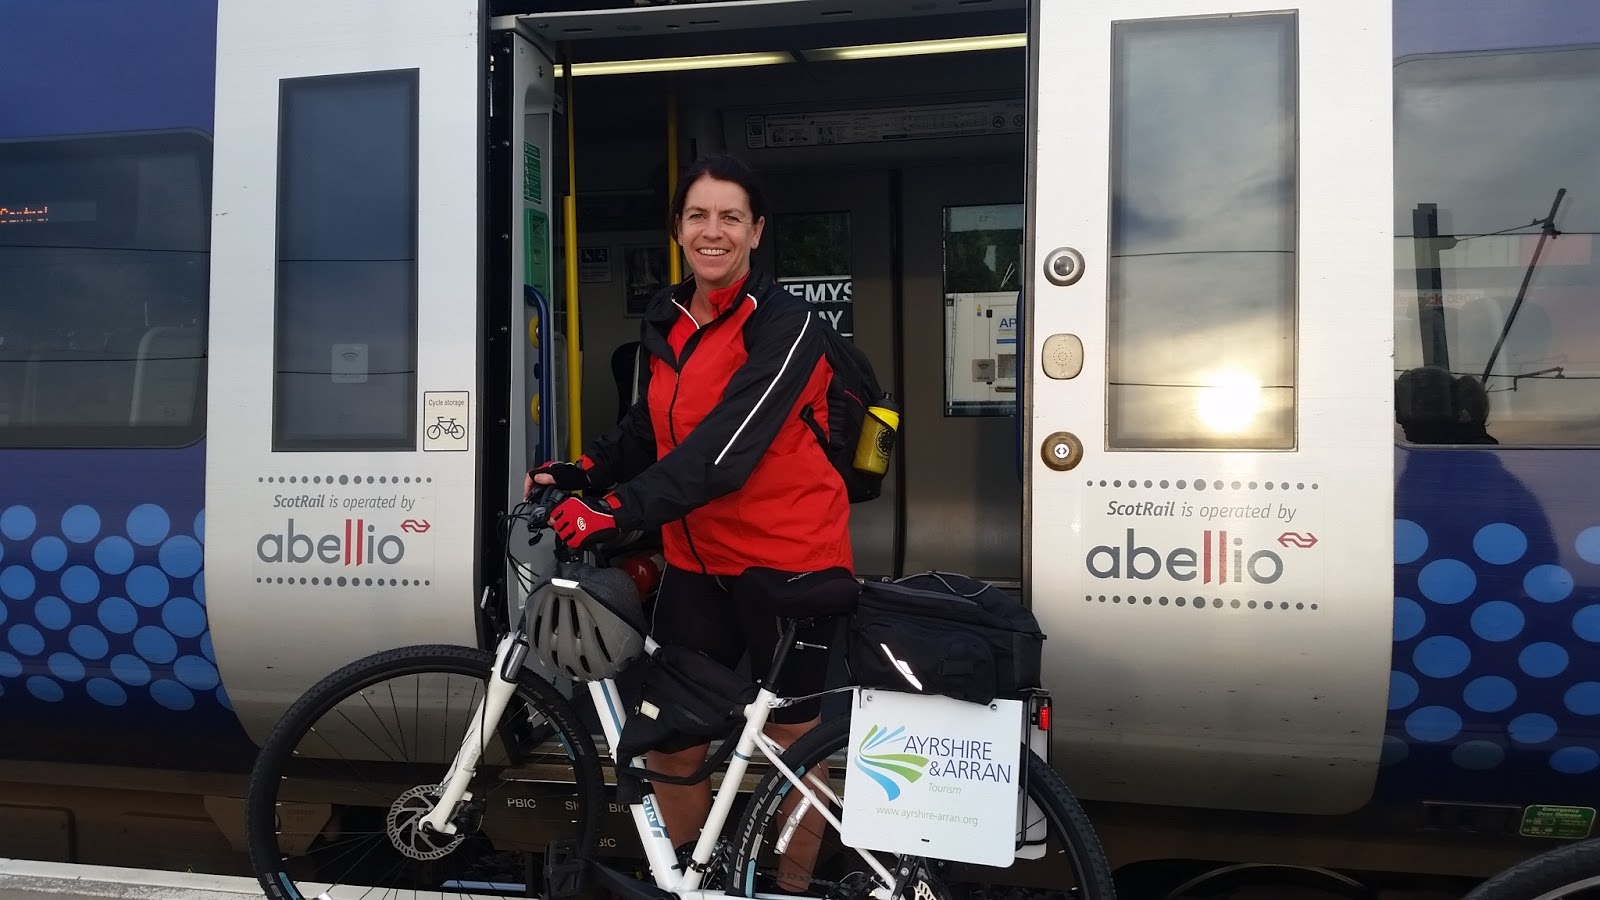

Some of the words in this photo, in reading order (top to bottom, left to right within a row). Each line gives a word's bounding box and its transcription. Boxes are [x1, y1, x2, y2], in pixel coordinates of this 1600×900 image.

[783, 282, 852, 302] EMYS
[428, 399, 443, 407] Cycle
[444, 399, 465, 407] storage
[273, 494, 325, 508] ScotRail
[329, 495, 338, 508] is
[343, 495, 397, 511] operated
[400, 495, 415, 511] by
[1106, 500, 1176, 517] ScotRail
[1181, 501, 1194, 517] is
[1199, 503, 1272, 521] operated
[1277, 503, 1297, 523] by
[256, 518, 405, 567] abellio
[1085, 528, 1284, 586] abellio
[903, 735, 993, 761] AYRSHIRE
[928, 782, 962, 795] Tourism
[507, 798, 536, 809] PBIC
[565, 800, 579, 811] SI
[876, 806, 979, 827] www.ayrshire-arran.org
